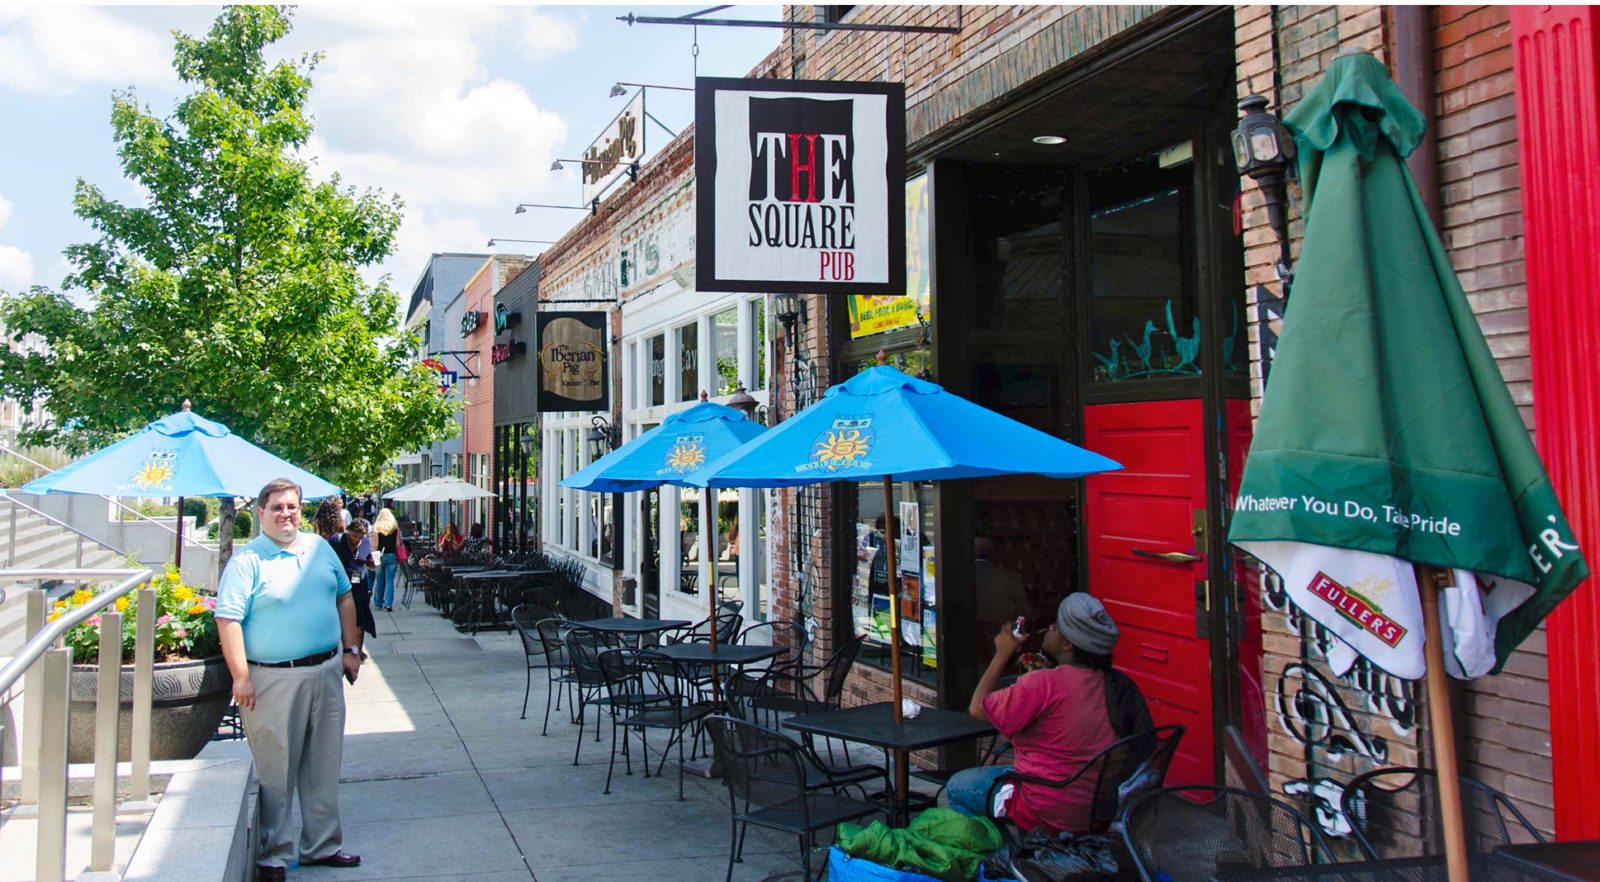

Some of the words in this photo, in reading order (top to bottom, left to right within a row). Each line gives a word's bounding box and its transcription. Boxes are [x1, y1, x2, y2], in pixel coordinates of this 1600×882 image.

[756, 132, 847, 203] THE
[748, 203, 855, 250] SQUARE
[819, 251, 855, 281] PUB
[551, 348, 596, 362] Iberian
[563, 362, 580, 375] Pig
[1235, 494, 1298, 512] Whatever
[1302, 495, 1338, 516] You
[1344, 500, 1378, 524] Do,
[1411, 513, 1461, 537] Pride
[1315, 577, 1398, 641] FULLER'S
